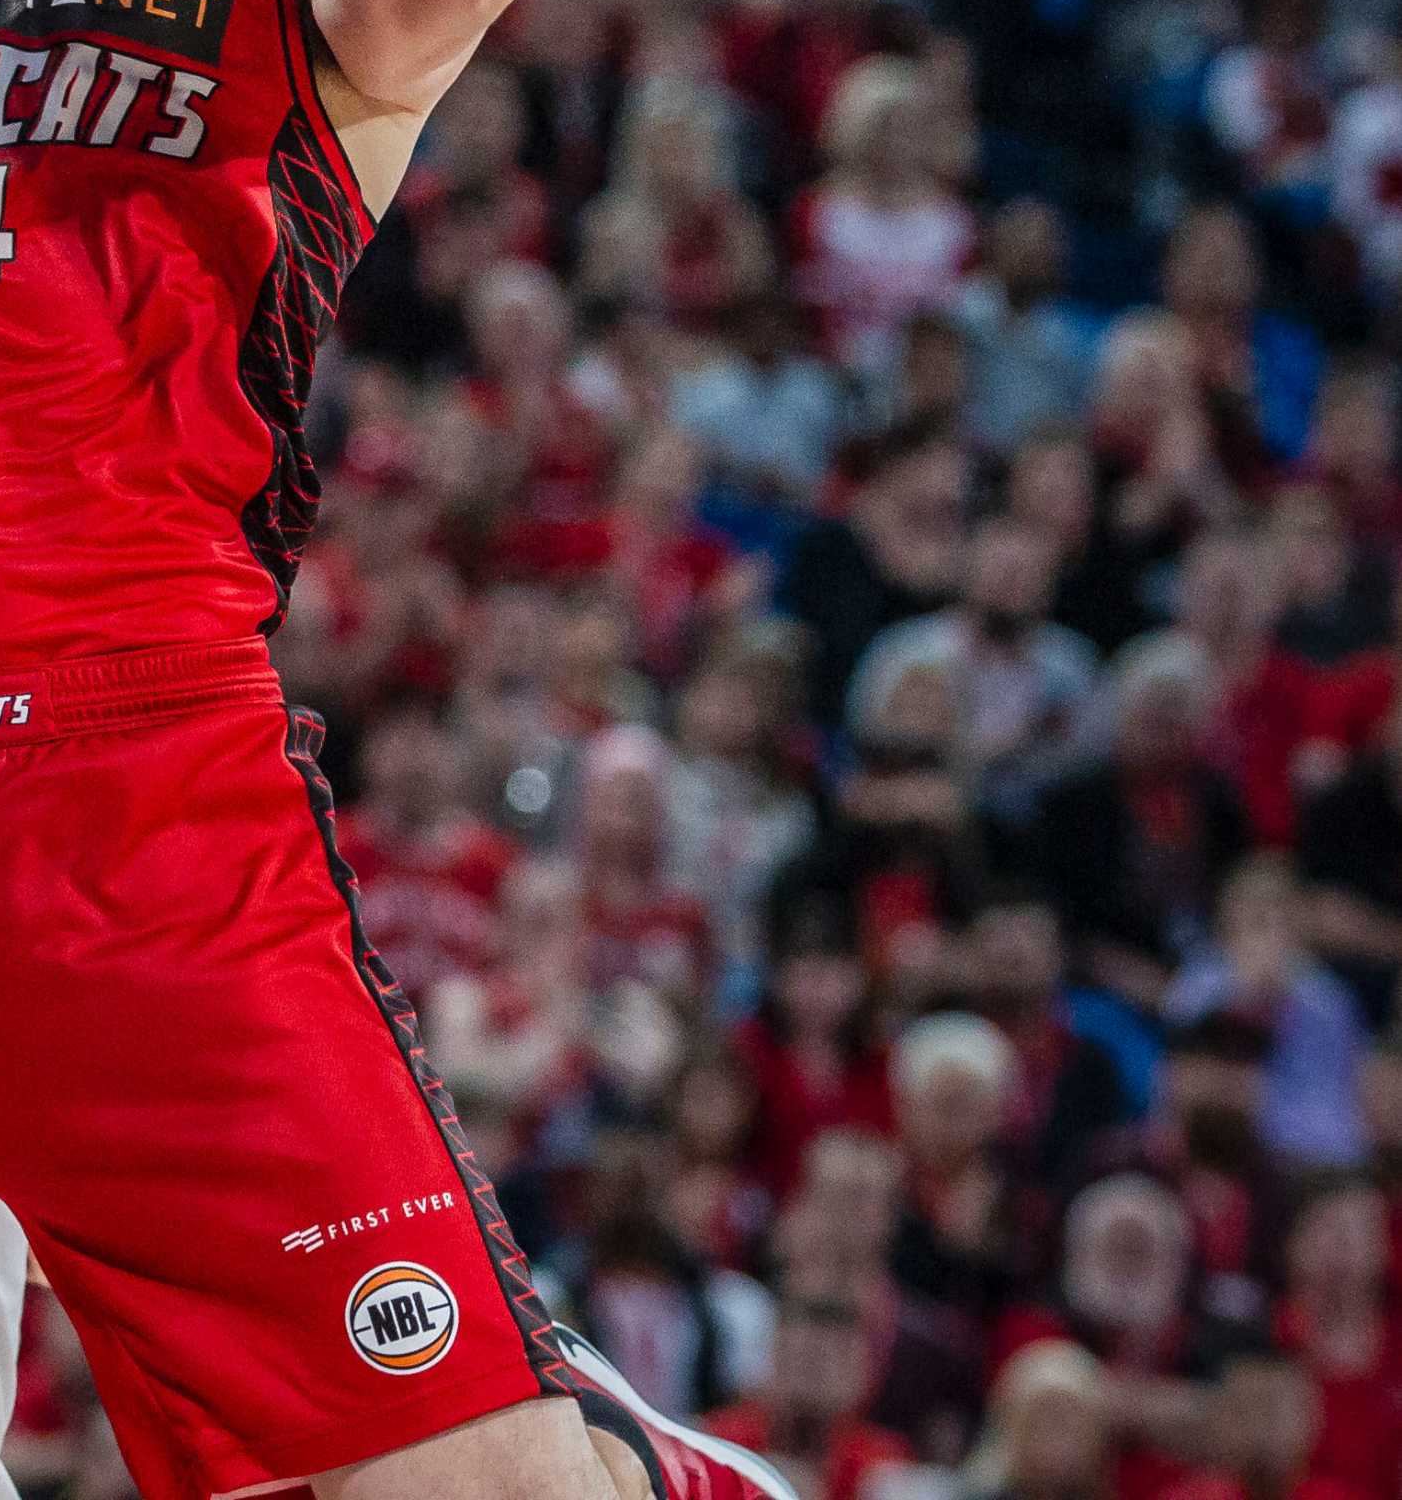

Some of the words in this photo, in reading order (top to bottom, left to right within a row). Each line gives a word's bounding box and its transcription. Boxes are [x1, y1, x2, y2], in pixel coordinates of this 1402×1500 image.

[327, 1206, 392, 1240] FIRST
[401, 1191, 456, 1219] EVER
[366, 1291, 437, 1346] NBL
